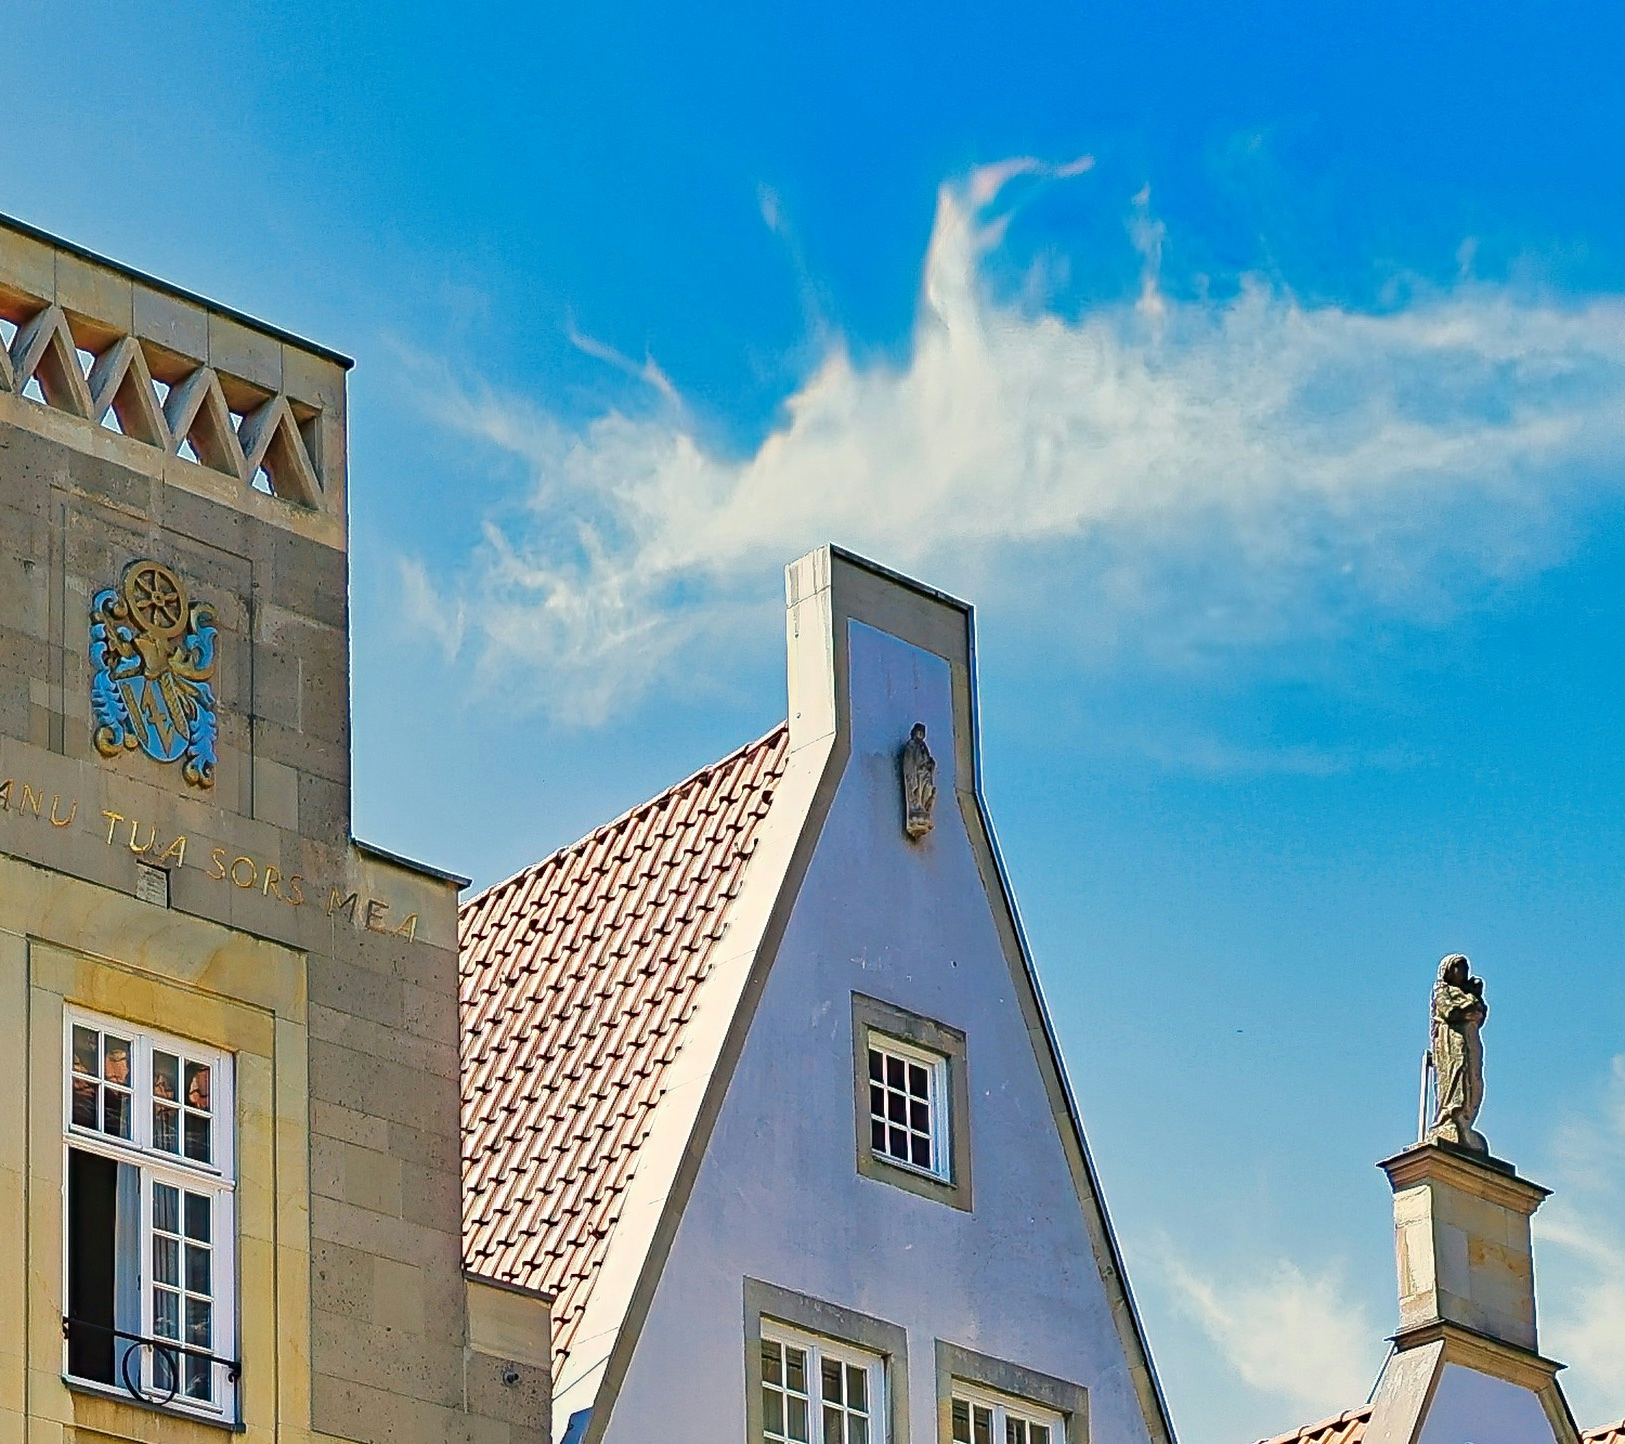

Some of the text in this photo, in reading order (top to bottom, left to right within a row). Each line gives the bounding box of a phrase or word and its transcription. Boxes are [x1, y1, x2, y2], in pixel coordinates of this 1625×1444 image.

[101, 809, 188, 869] TUA
[205, 847, 306, 908] SORS
[326, 889, 421, 944] MEA
